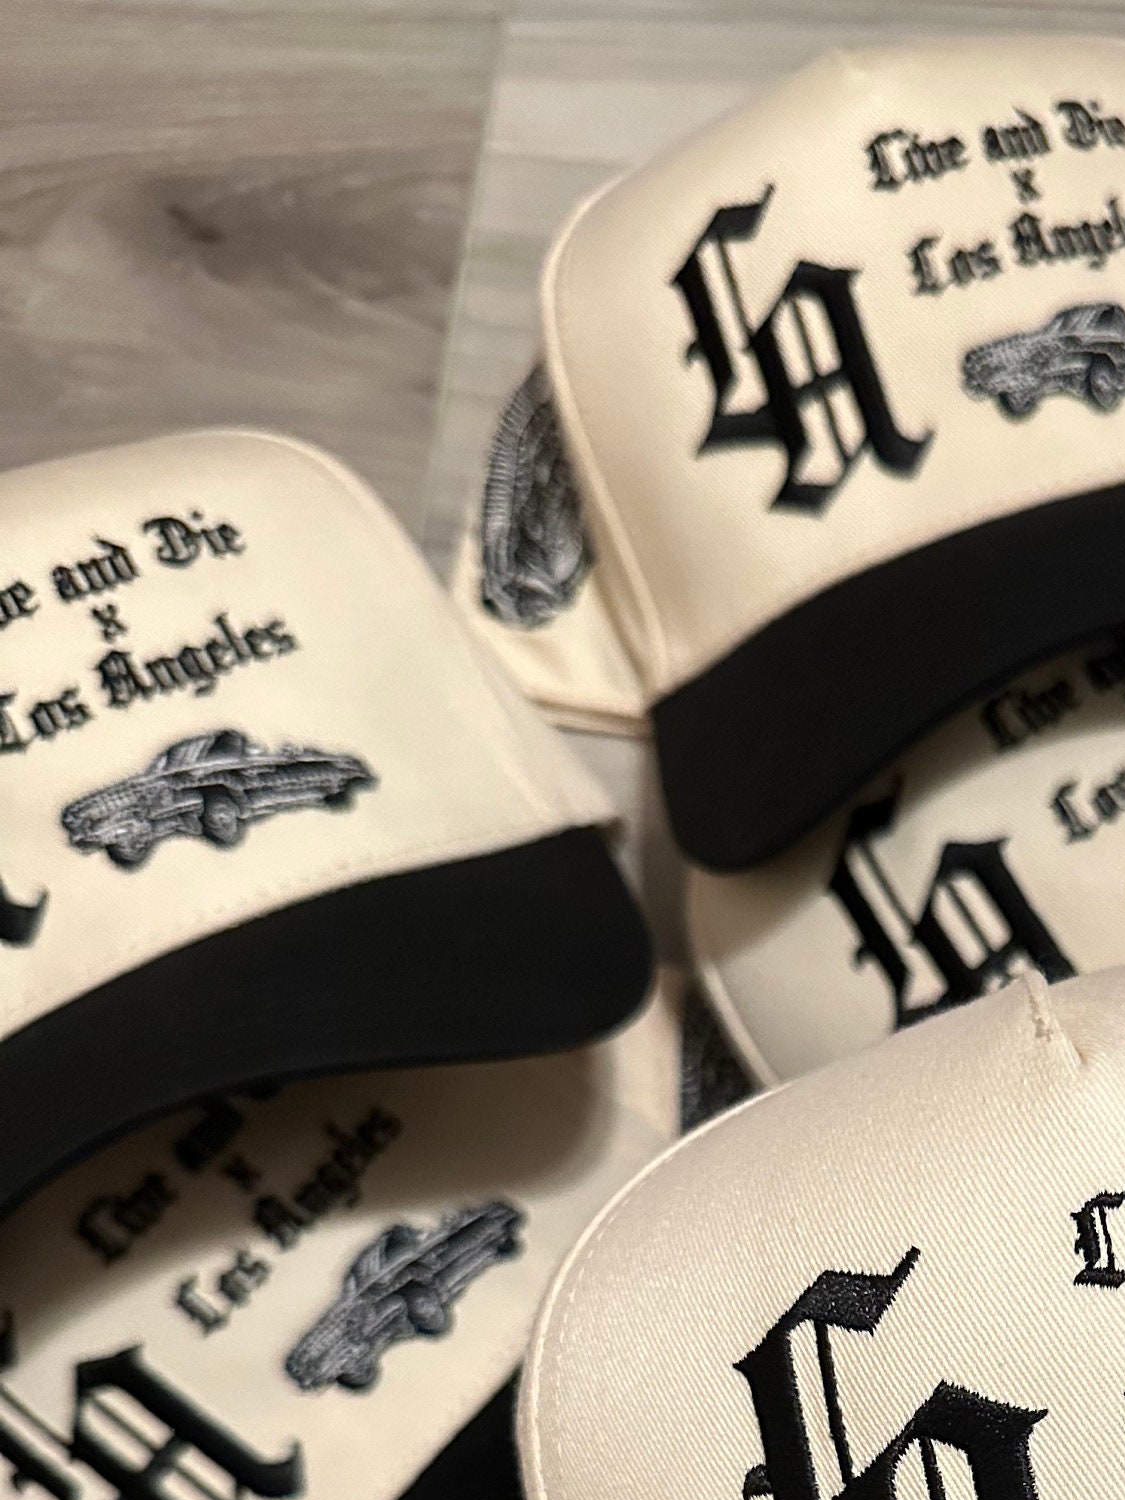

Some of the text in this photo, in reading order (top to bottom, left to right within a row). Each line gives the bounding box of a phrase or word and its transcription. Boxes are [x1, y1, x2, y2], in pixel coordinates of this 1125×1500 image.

[866, 127, 968, 192] Live
[983, 107, 1052, 164] and
[906, 234, 1003, 296] Los
[50, 534, 140, 604] and
[142, 508, 247, 569] Die
[93, 611, 301, 710] Angeles
[174, 1250, 272, 1338] Los
